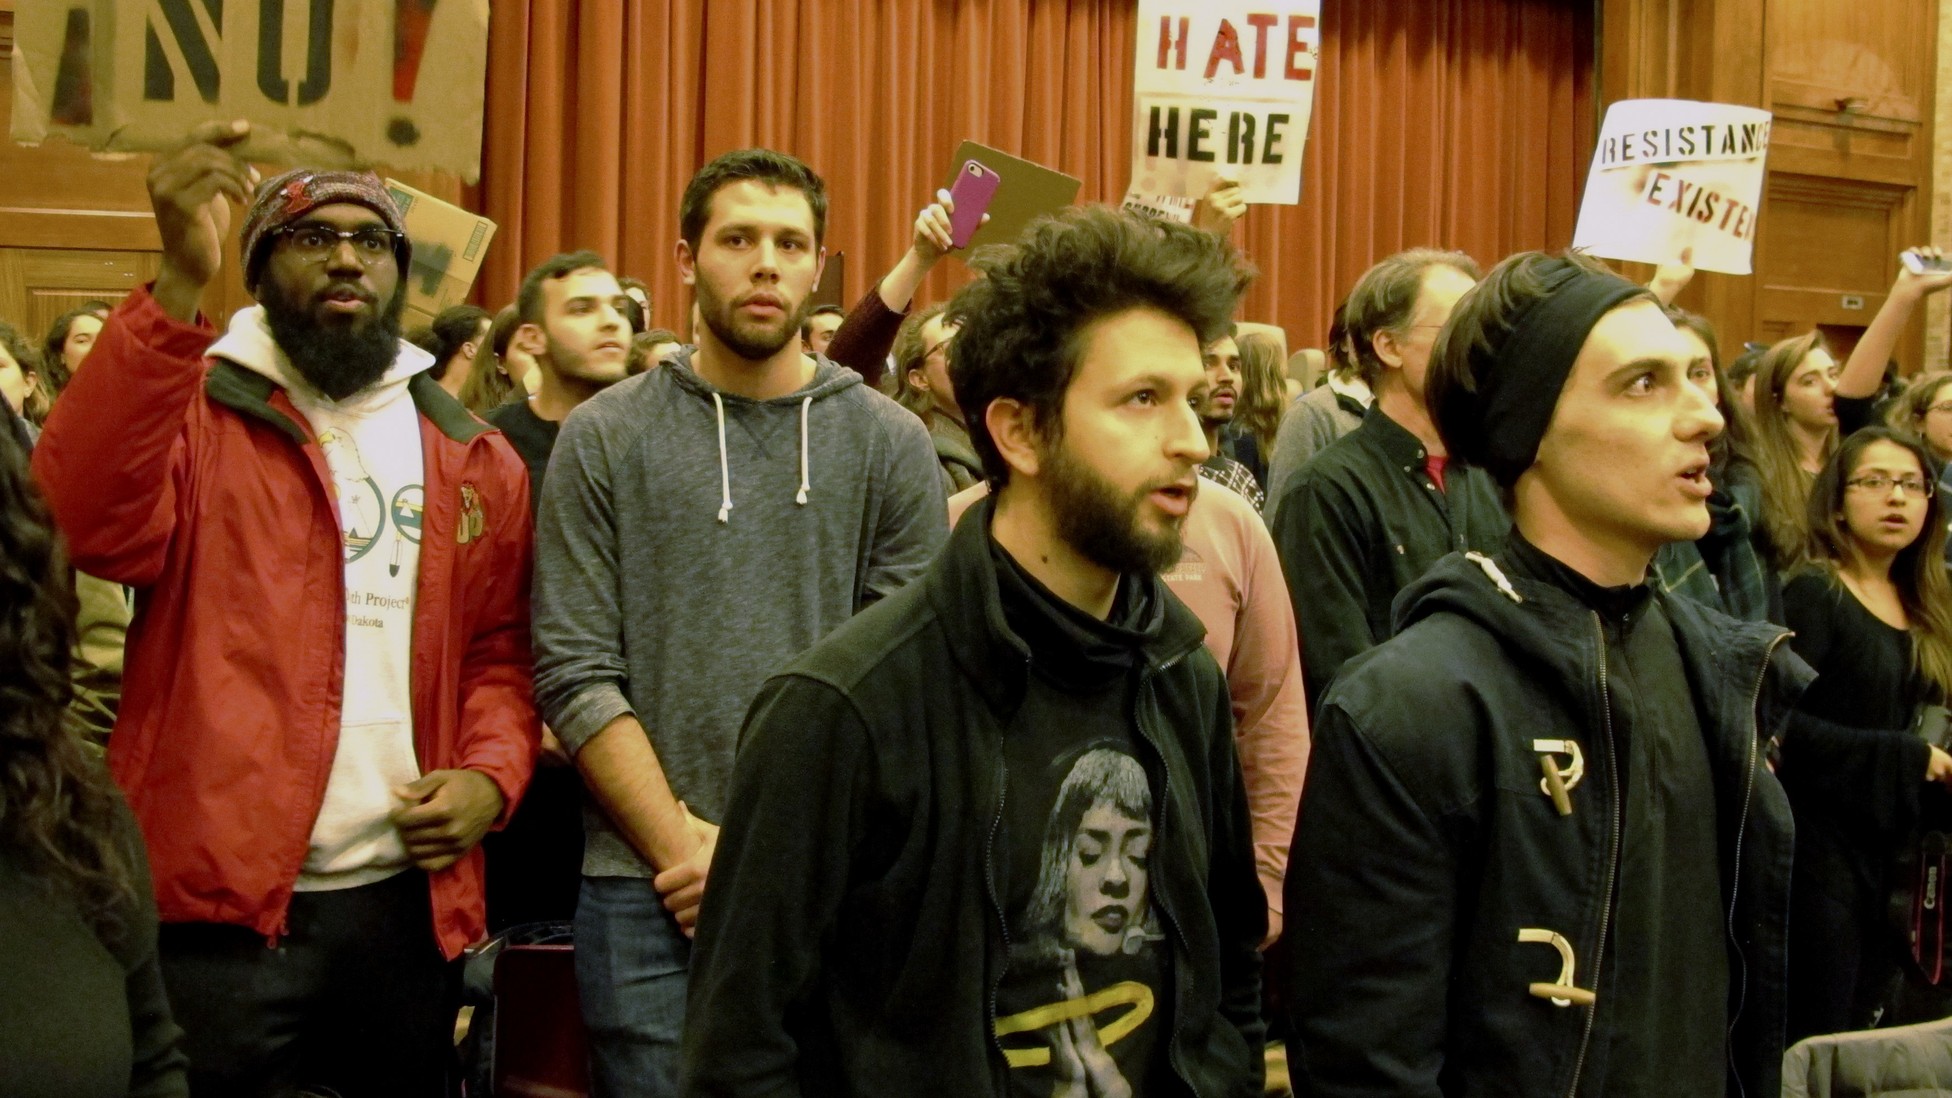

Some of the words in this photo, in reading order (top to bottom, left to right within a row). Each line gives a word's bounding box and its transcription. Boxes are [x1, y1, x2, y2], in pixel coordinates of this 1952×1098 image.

[1157, 13, 1315, 81] HATE
[1147, 106, 1290, 164] HERE
[351, 614, 384, 629] Dakota
[1924, 866, 1937, 909] Canon
